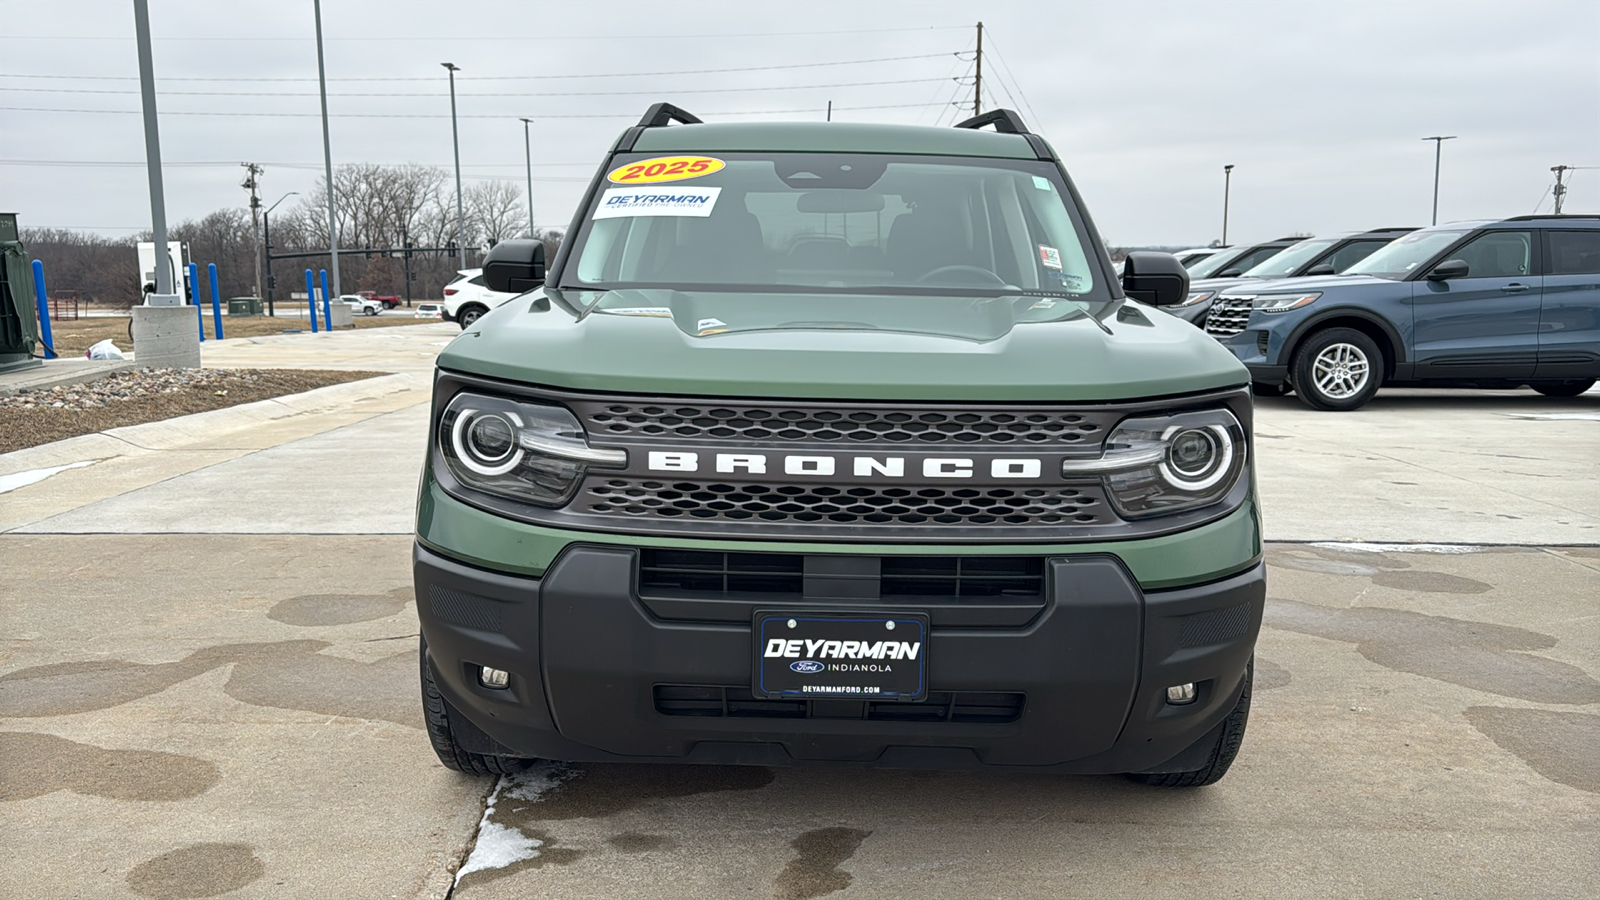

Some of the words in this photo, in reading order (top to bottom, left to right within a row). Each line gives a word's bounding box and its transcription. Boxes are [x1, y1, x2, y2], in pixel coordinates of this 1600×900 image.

[619, 160, 712, 180] 2025
[606, 194, 710, 205] DEYARMAN
[648, 451, 1042, 478] BRONCO
[764, 638, 921, 660] DEYARMAN
[796, 660, 818, 671] Ford
[828, 663, 892, 672] INDIANOLA
[802, 685, 880, 694] DEYARMANFORD.COM
